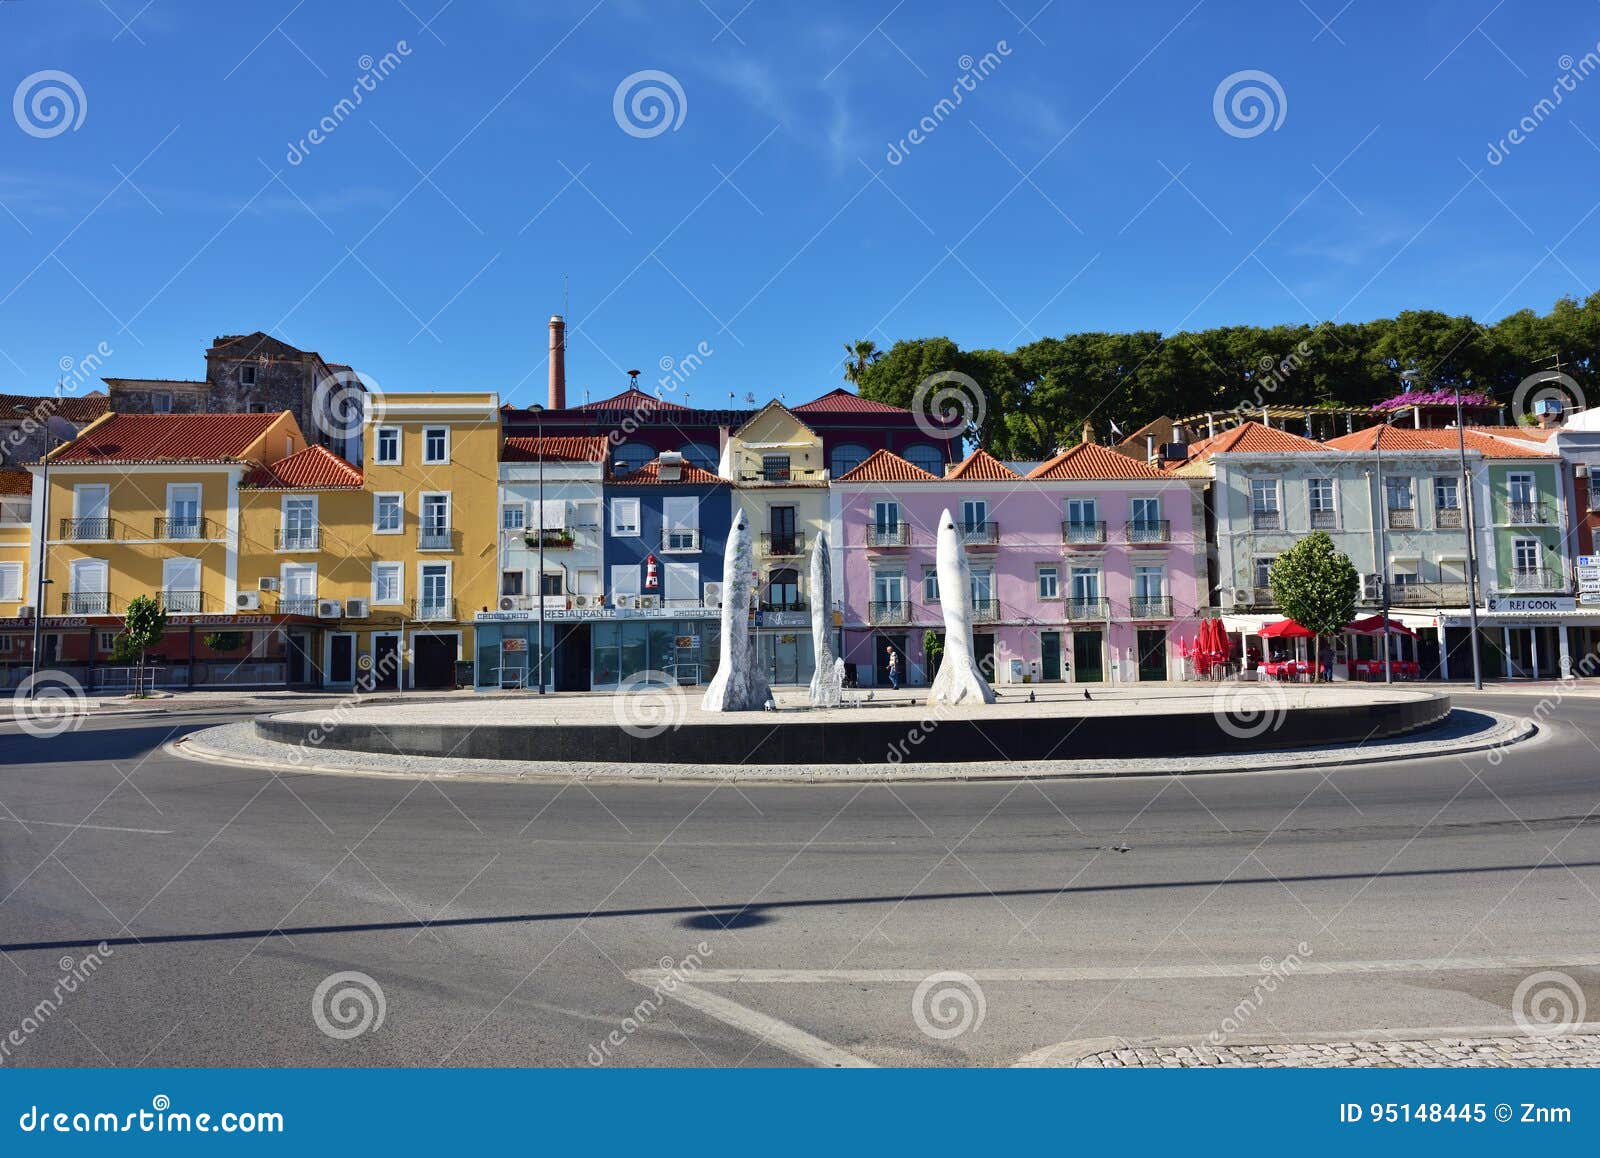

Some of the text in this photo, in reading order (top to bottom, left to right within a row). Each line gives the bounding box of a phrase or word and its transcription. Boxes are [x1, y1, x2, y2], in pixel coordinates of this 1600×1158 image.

[597, 409, 657, 424] MUSU
[1509, 601, 1557, 610] REI COOK
[544, 608, 616, 619] RESTAURANTE
[29, 618, 88, 627] SNTIAGO
[237, 615, 272, 624] FRITO
